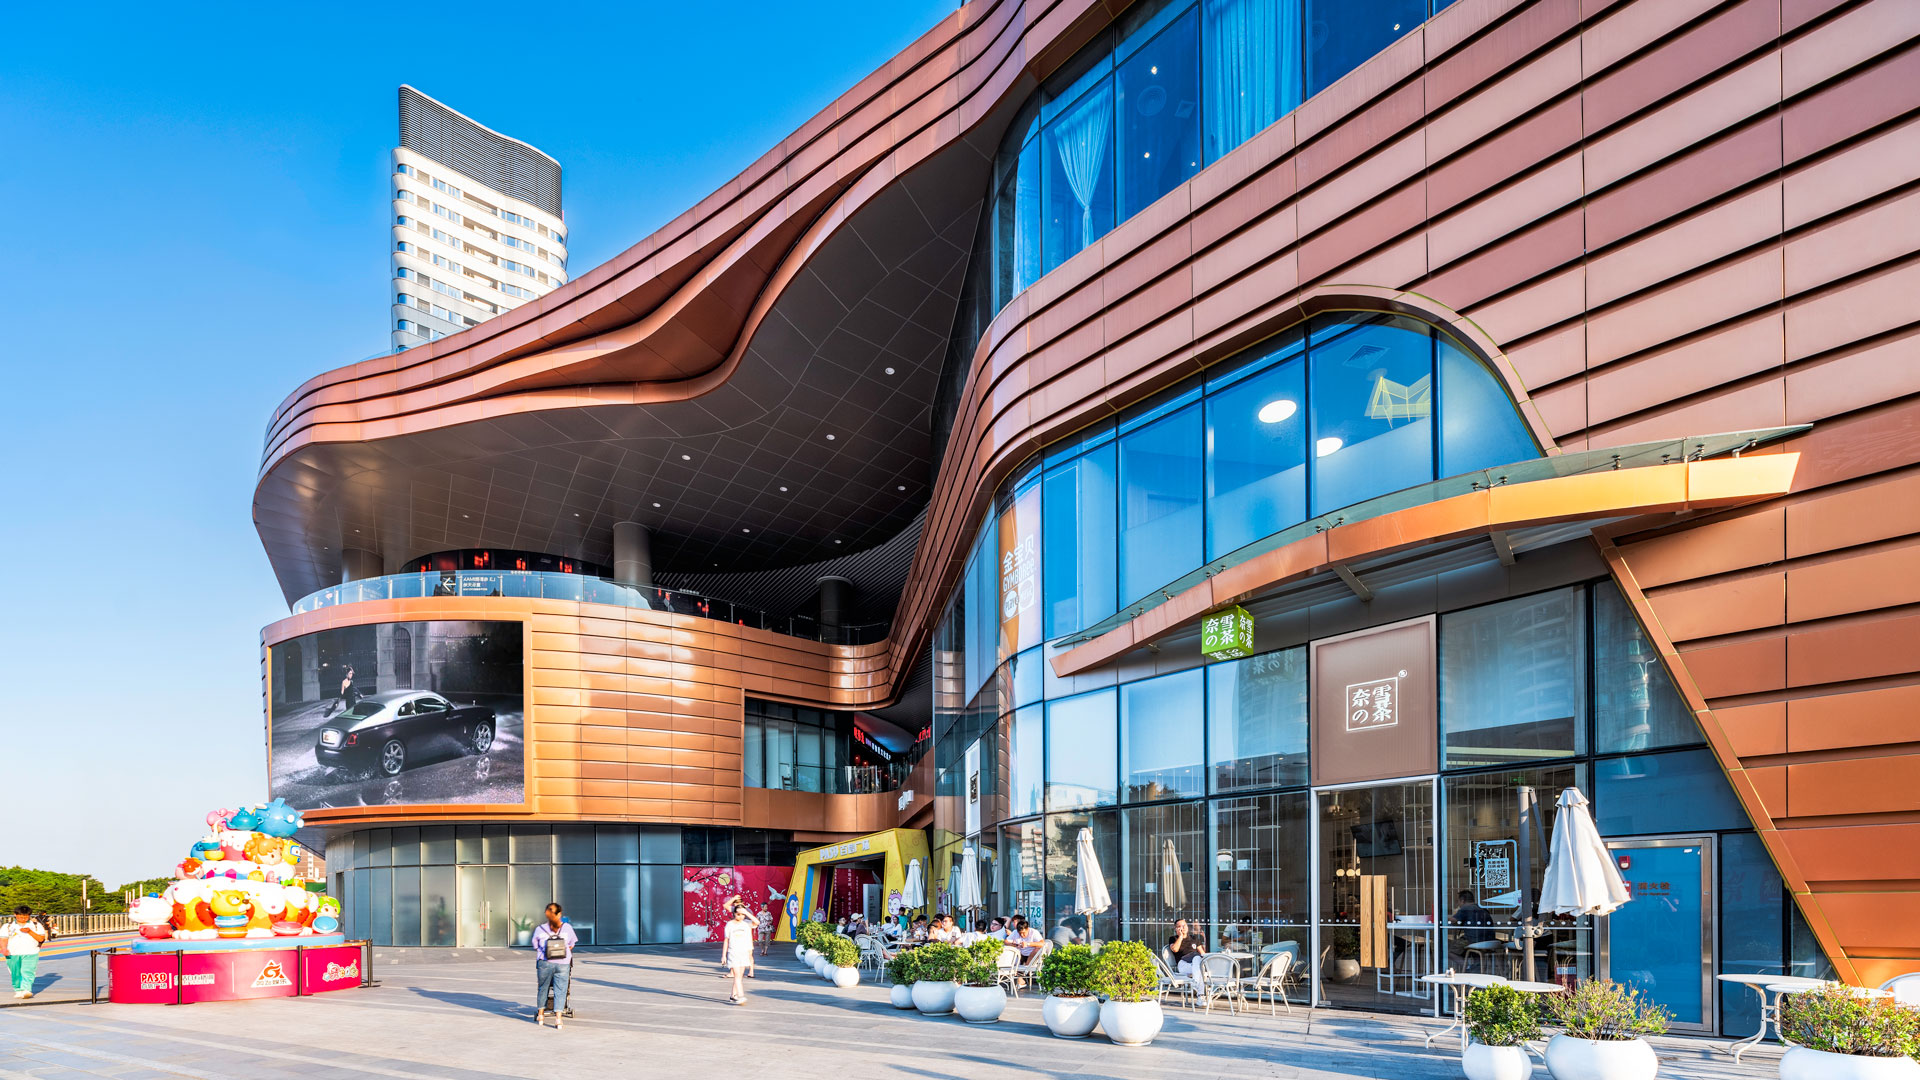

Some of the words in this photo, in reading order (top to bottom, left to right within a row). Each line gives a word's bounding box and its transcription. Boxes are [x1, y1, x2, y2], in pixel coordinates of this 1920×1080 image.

[1003, 534, 1034, 575] 金宝贝
[140, 972, 167, 984] PASO
